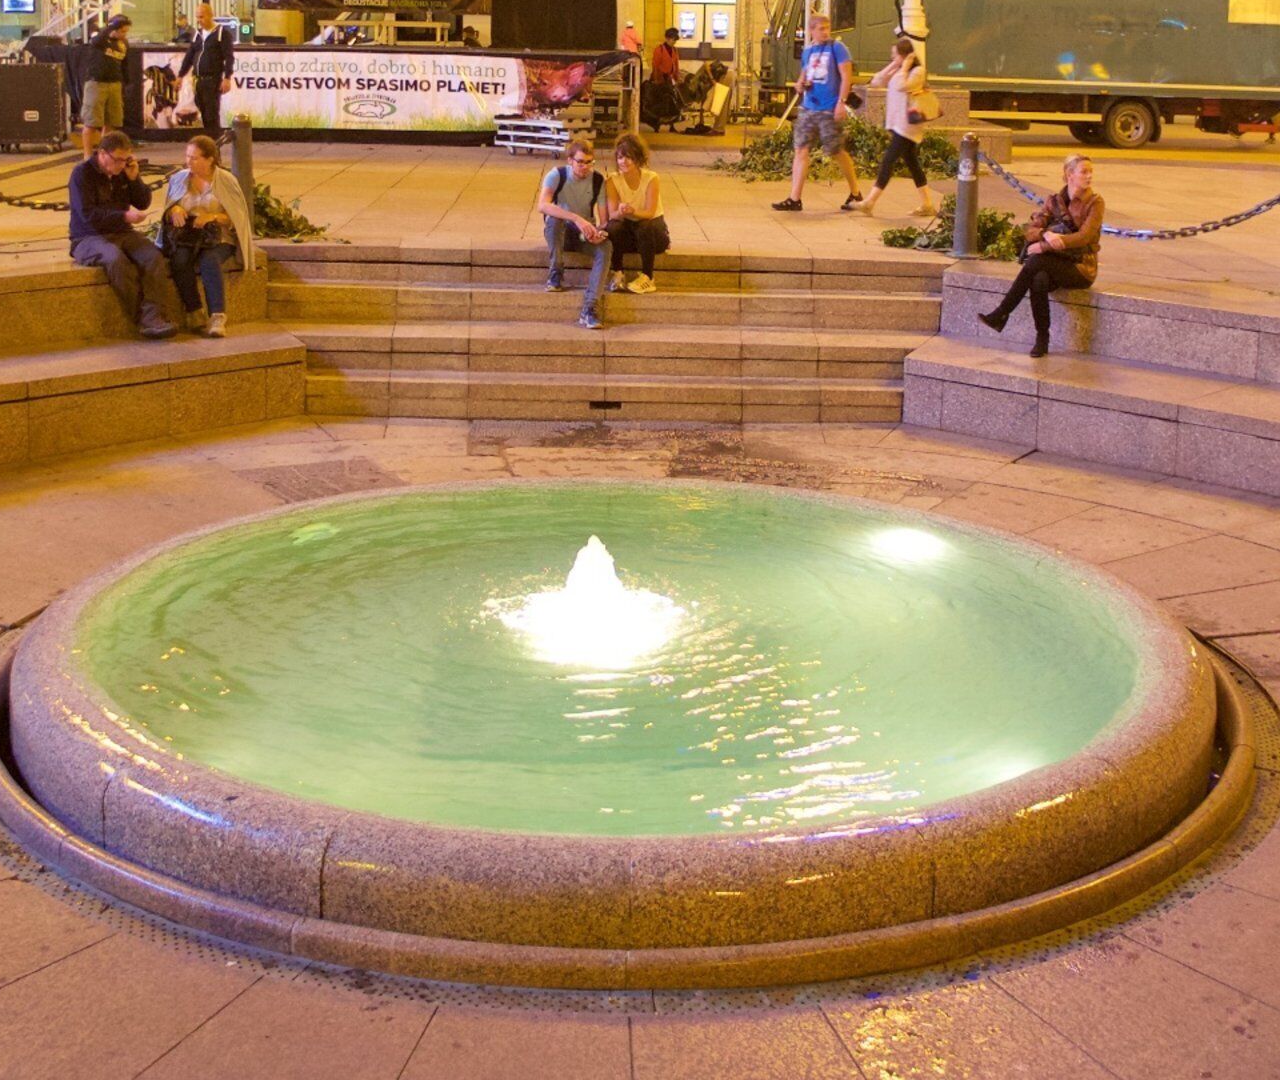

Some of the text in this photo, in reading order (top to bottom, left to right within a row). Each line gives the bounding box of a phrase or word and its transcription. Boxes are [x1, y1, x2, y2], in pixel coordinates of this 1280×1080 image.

[235, 57, 295, 73] Jedimo
[367, 59, 417, 75] dobro
[421, 60, 428, 76] i
[432, 60, 507, 78] humano
[234, 77, 506, 95] VEGANSTVOM SPASIMO PLANET!
